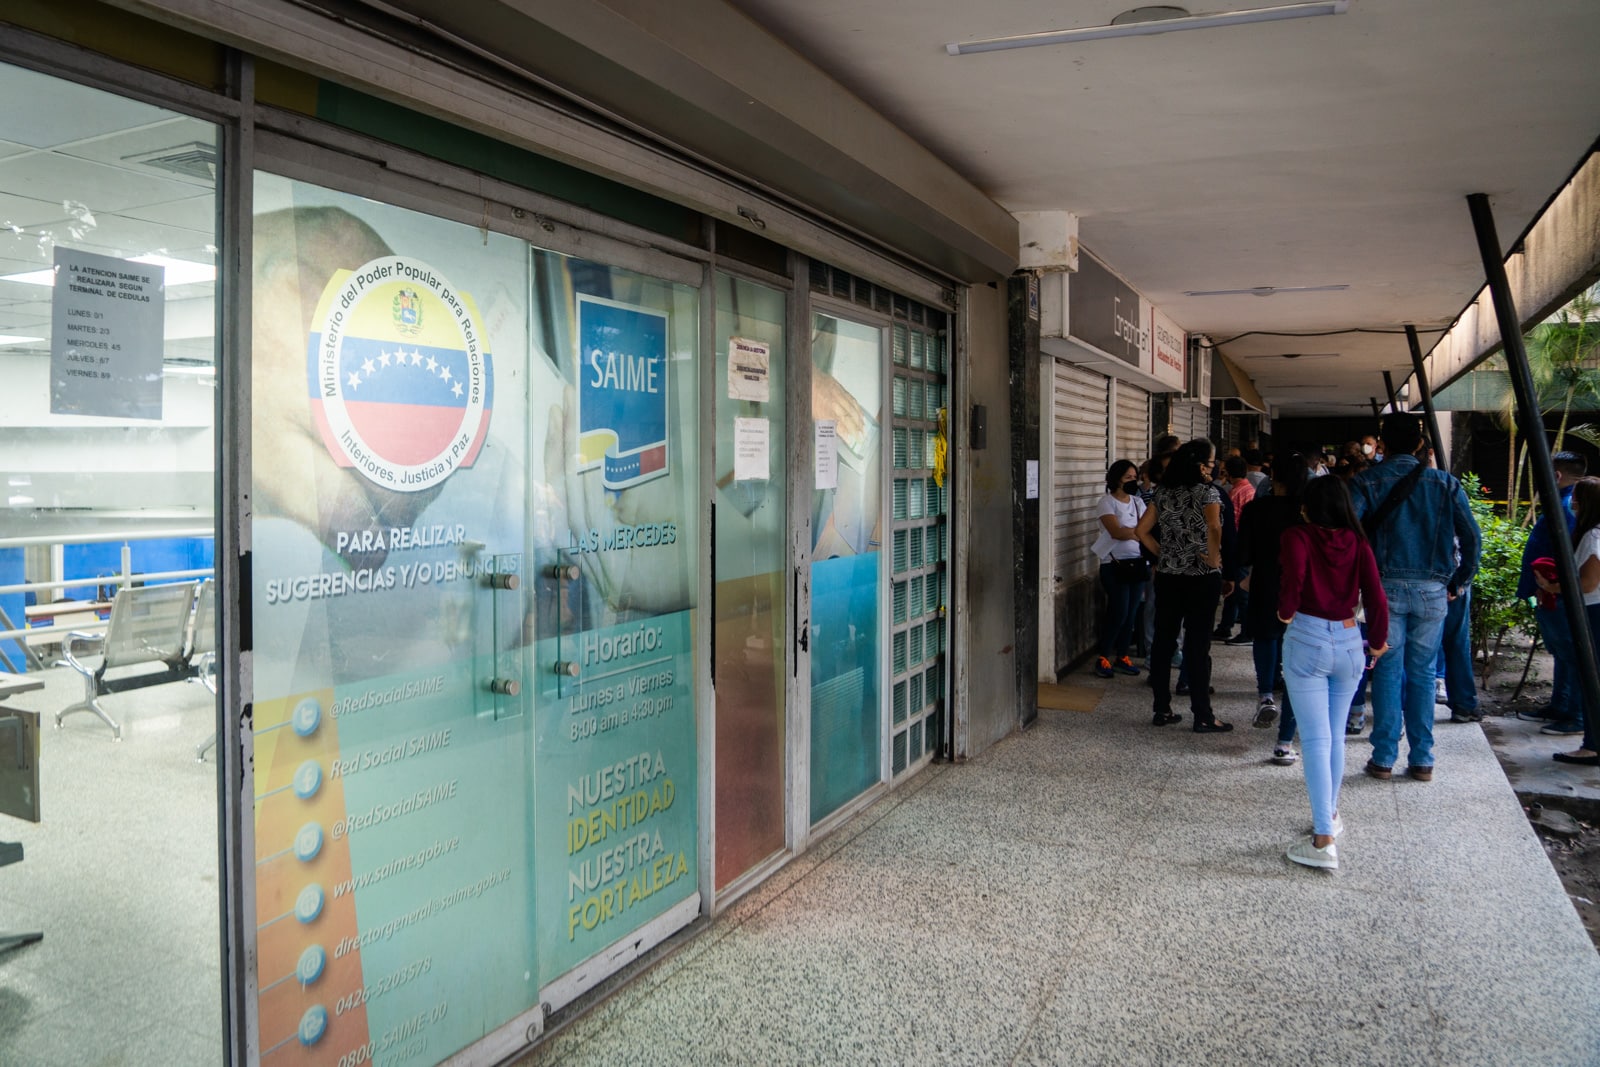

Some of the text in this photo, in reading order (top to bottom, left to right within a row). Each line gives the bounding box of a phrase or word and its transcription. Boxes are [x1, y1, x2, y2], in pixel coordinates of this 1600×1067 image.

[69, 264, 151, 284] LA ATENCION SAIME SE
[69, 284, 150, 303] TERMINAL DE CEDULAS
[77, 275, 143, 292] REALIZARA SEGUN
[323, 262, 479, 404] Ministerio del Poder Popular para Relaciones
[591, 349, 658, 394] SAIME
[341, 429, 470, 486] Interiores, Justicia y Paz
[336, 524, 466, 553] PARA REALIZAR
[568, 524, 676, 555] LAS MERCEDES
[265, 566, 396, 604] SUGERENCIAS
[401, 561, 432, 587] Y/O
[583, 622, 663, 667] Horario:
[329, 675, 445, 719] @RedSocialSAIME
[570, 669, 674, 715] Lunes a Viernes
[570, 694, 674, 742] 8:00 am a 4:30 pm
[330, 729, 451, 780] Red Social SAIME
[567, 749, 668, 816] NUESTRA
[331, 779, 458, 841] @RedSocialSAIME
[567, 779, 676, 856] IDENTIDAD
[333, 836, 460, 898] www.saime.gob.ve
[568, 828, 665, 903] NUESTRA
[334, 868, 511, 959] directorgeneral@saime.gob.ve
[568, 851, 689, 942] FORTALEZA
